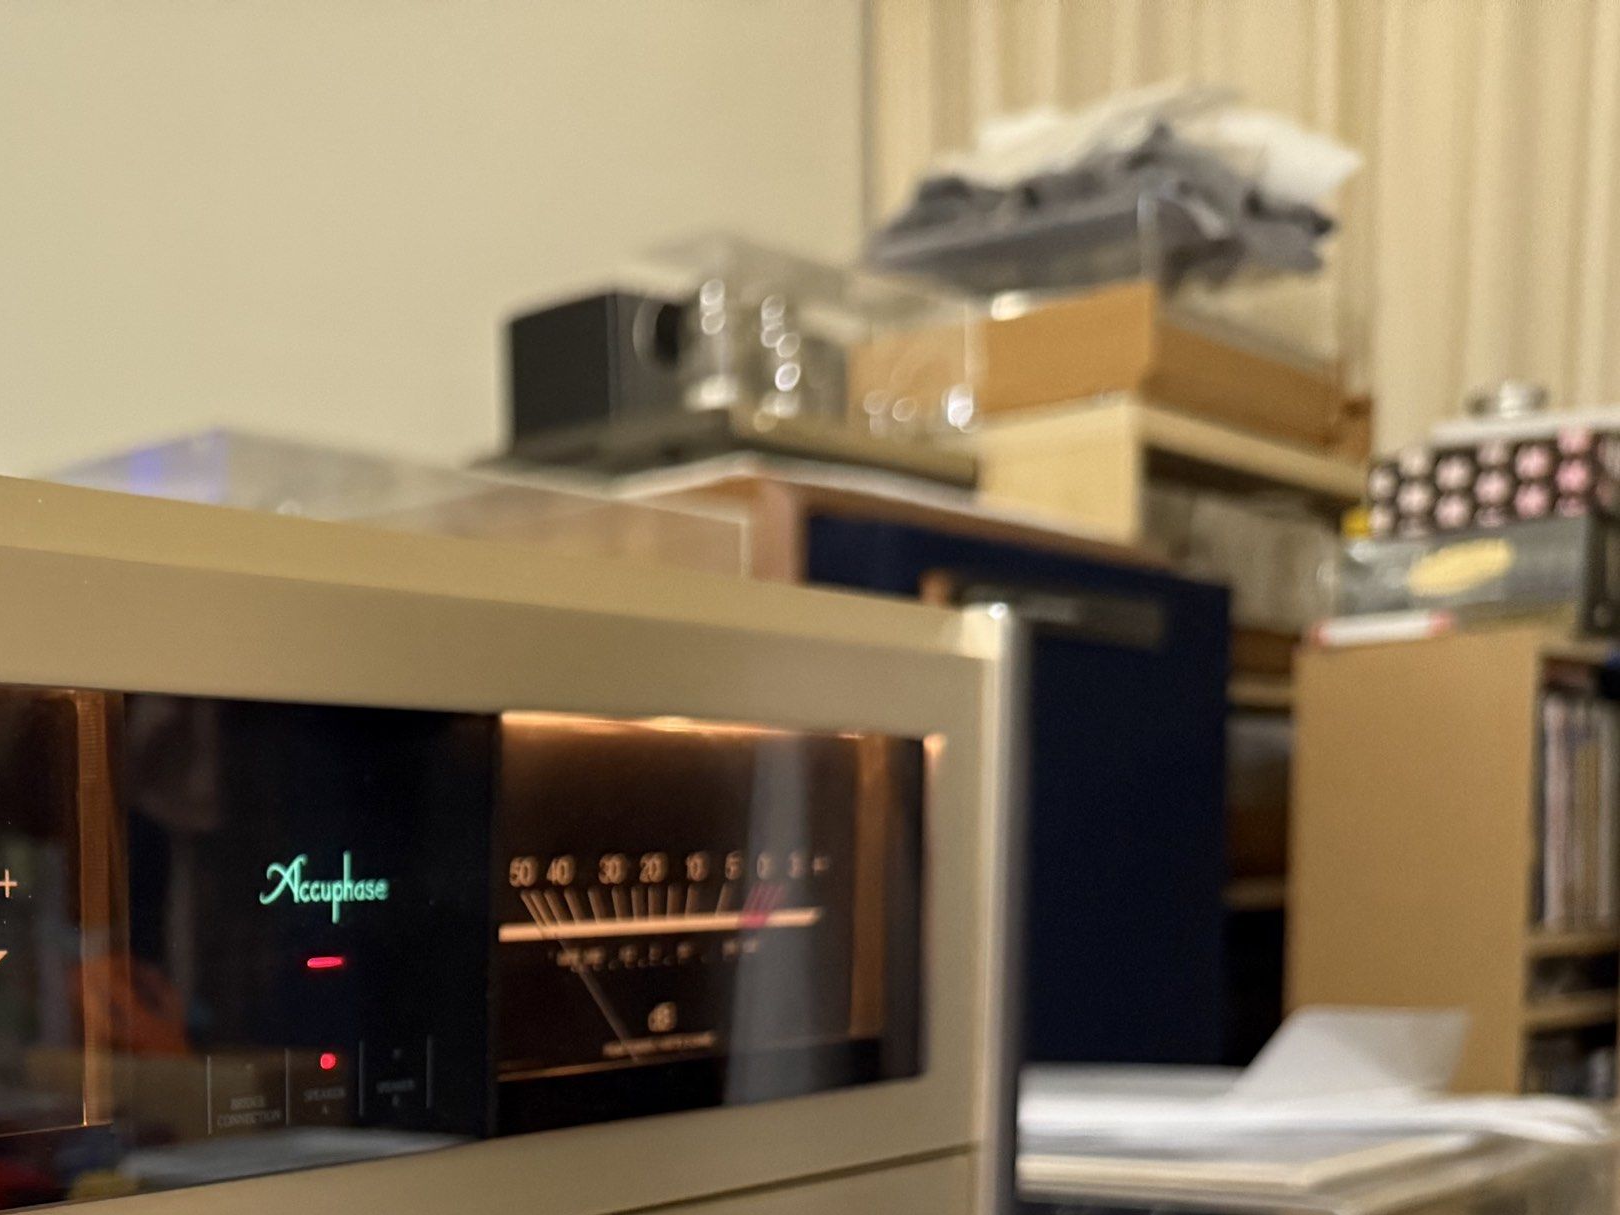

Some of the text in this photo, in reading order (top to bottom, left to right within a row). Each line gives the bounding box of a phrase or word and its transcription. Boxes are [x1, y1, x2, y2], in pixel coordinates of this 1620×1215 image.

[259, 850, 390, 925] Accuphase
[509, 856, 538, 887] 50
[546, 855, 575, 886] 40
[598, 852, 627, 885] 30
[639, 852, 668, 884] 20
